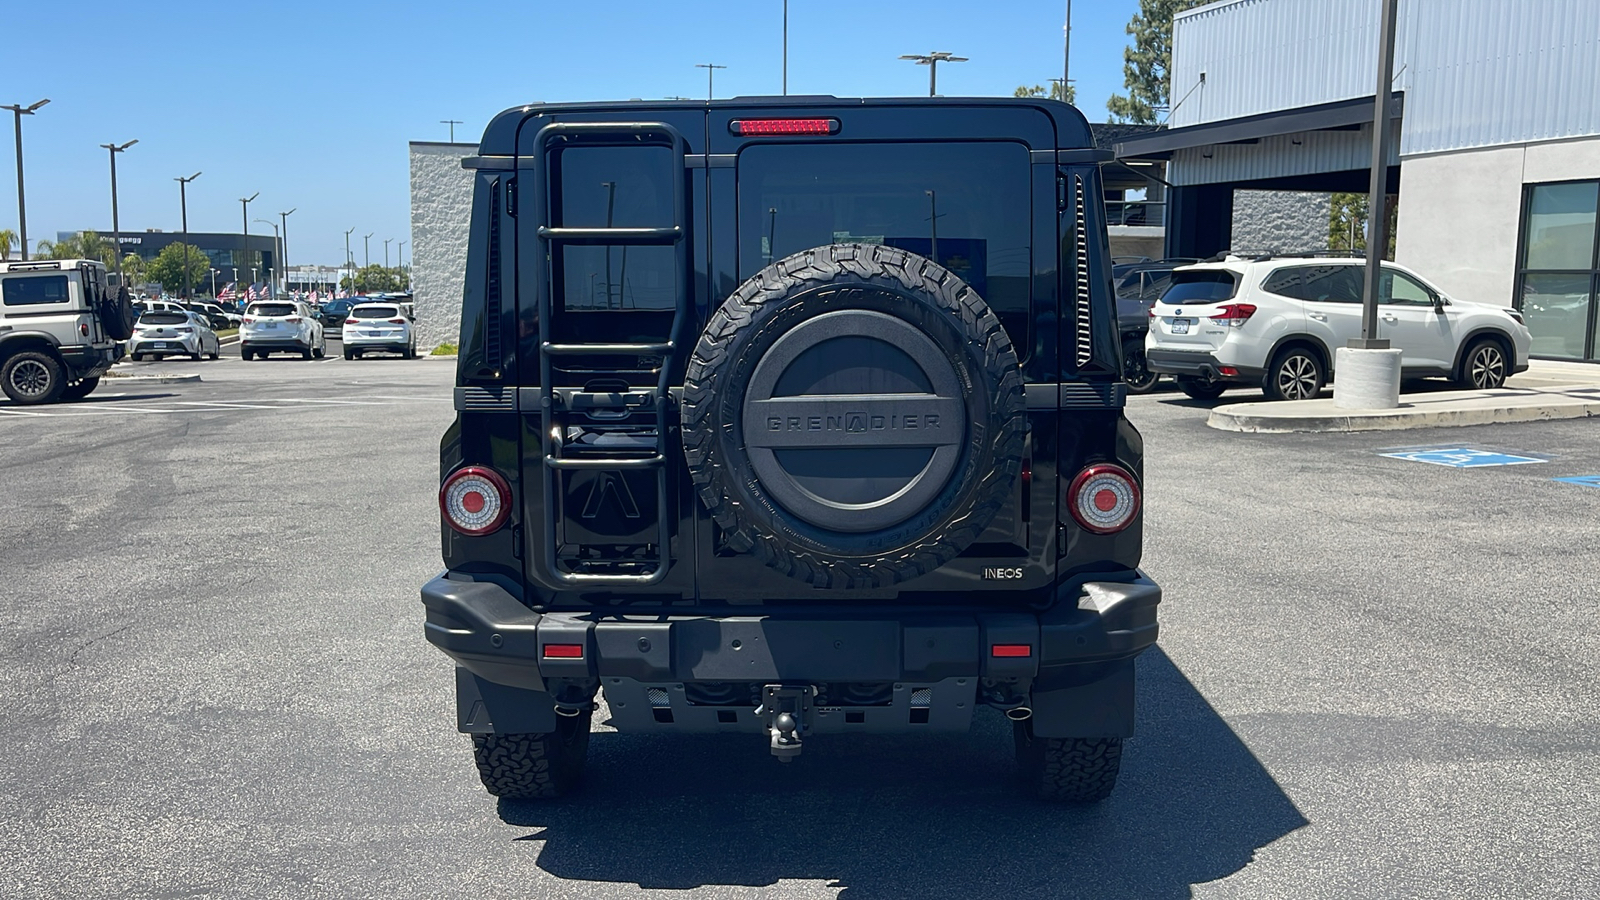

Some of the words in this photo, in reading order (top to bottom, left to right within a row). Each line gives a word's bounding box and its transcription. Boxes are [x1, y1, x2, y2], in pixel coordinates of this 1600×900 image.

[99, 236, 142, 244] Kgsegg
[766, 412, 941, 433] GRENADIER
[985, 568, 1023, 579] INEOS
